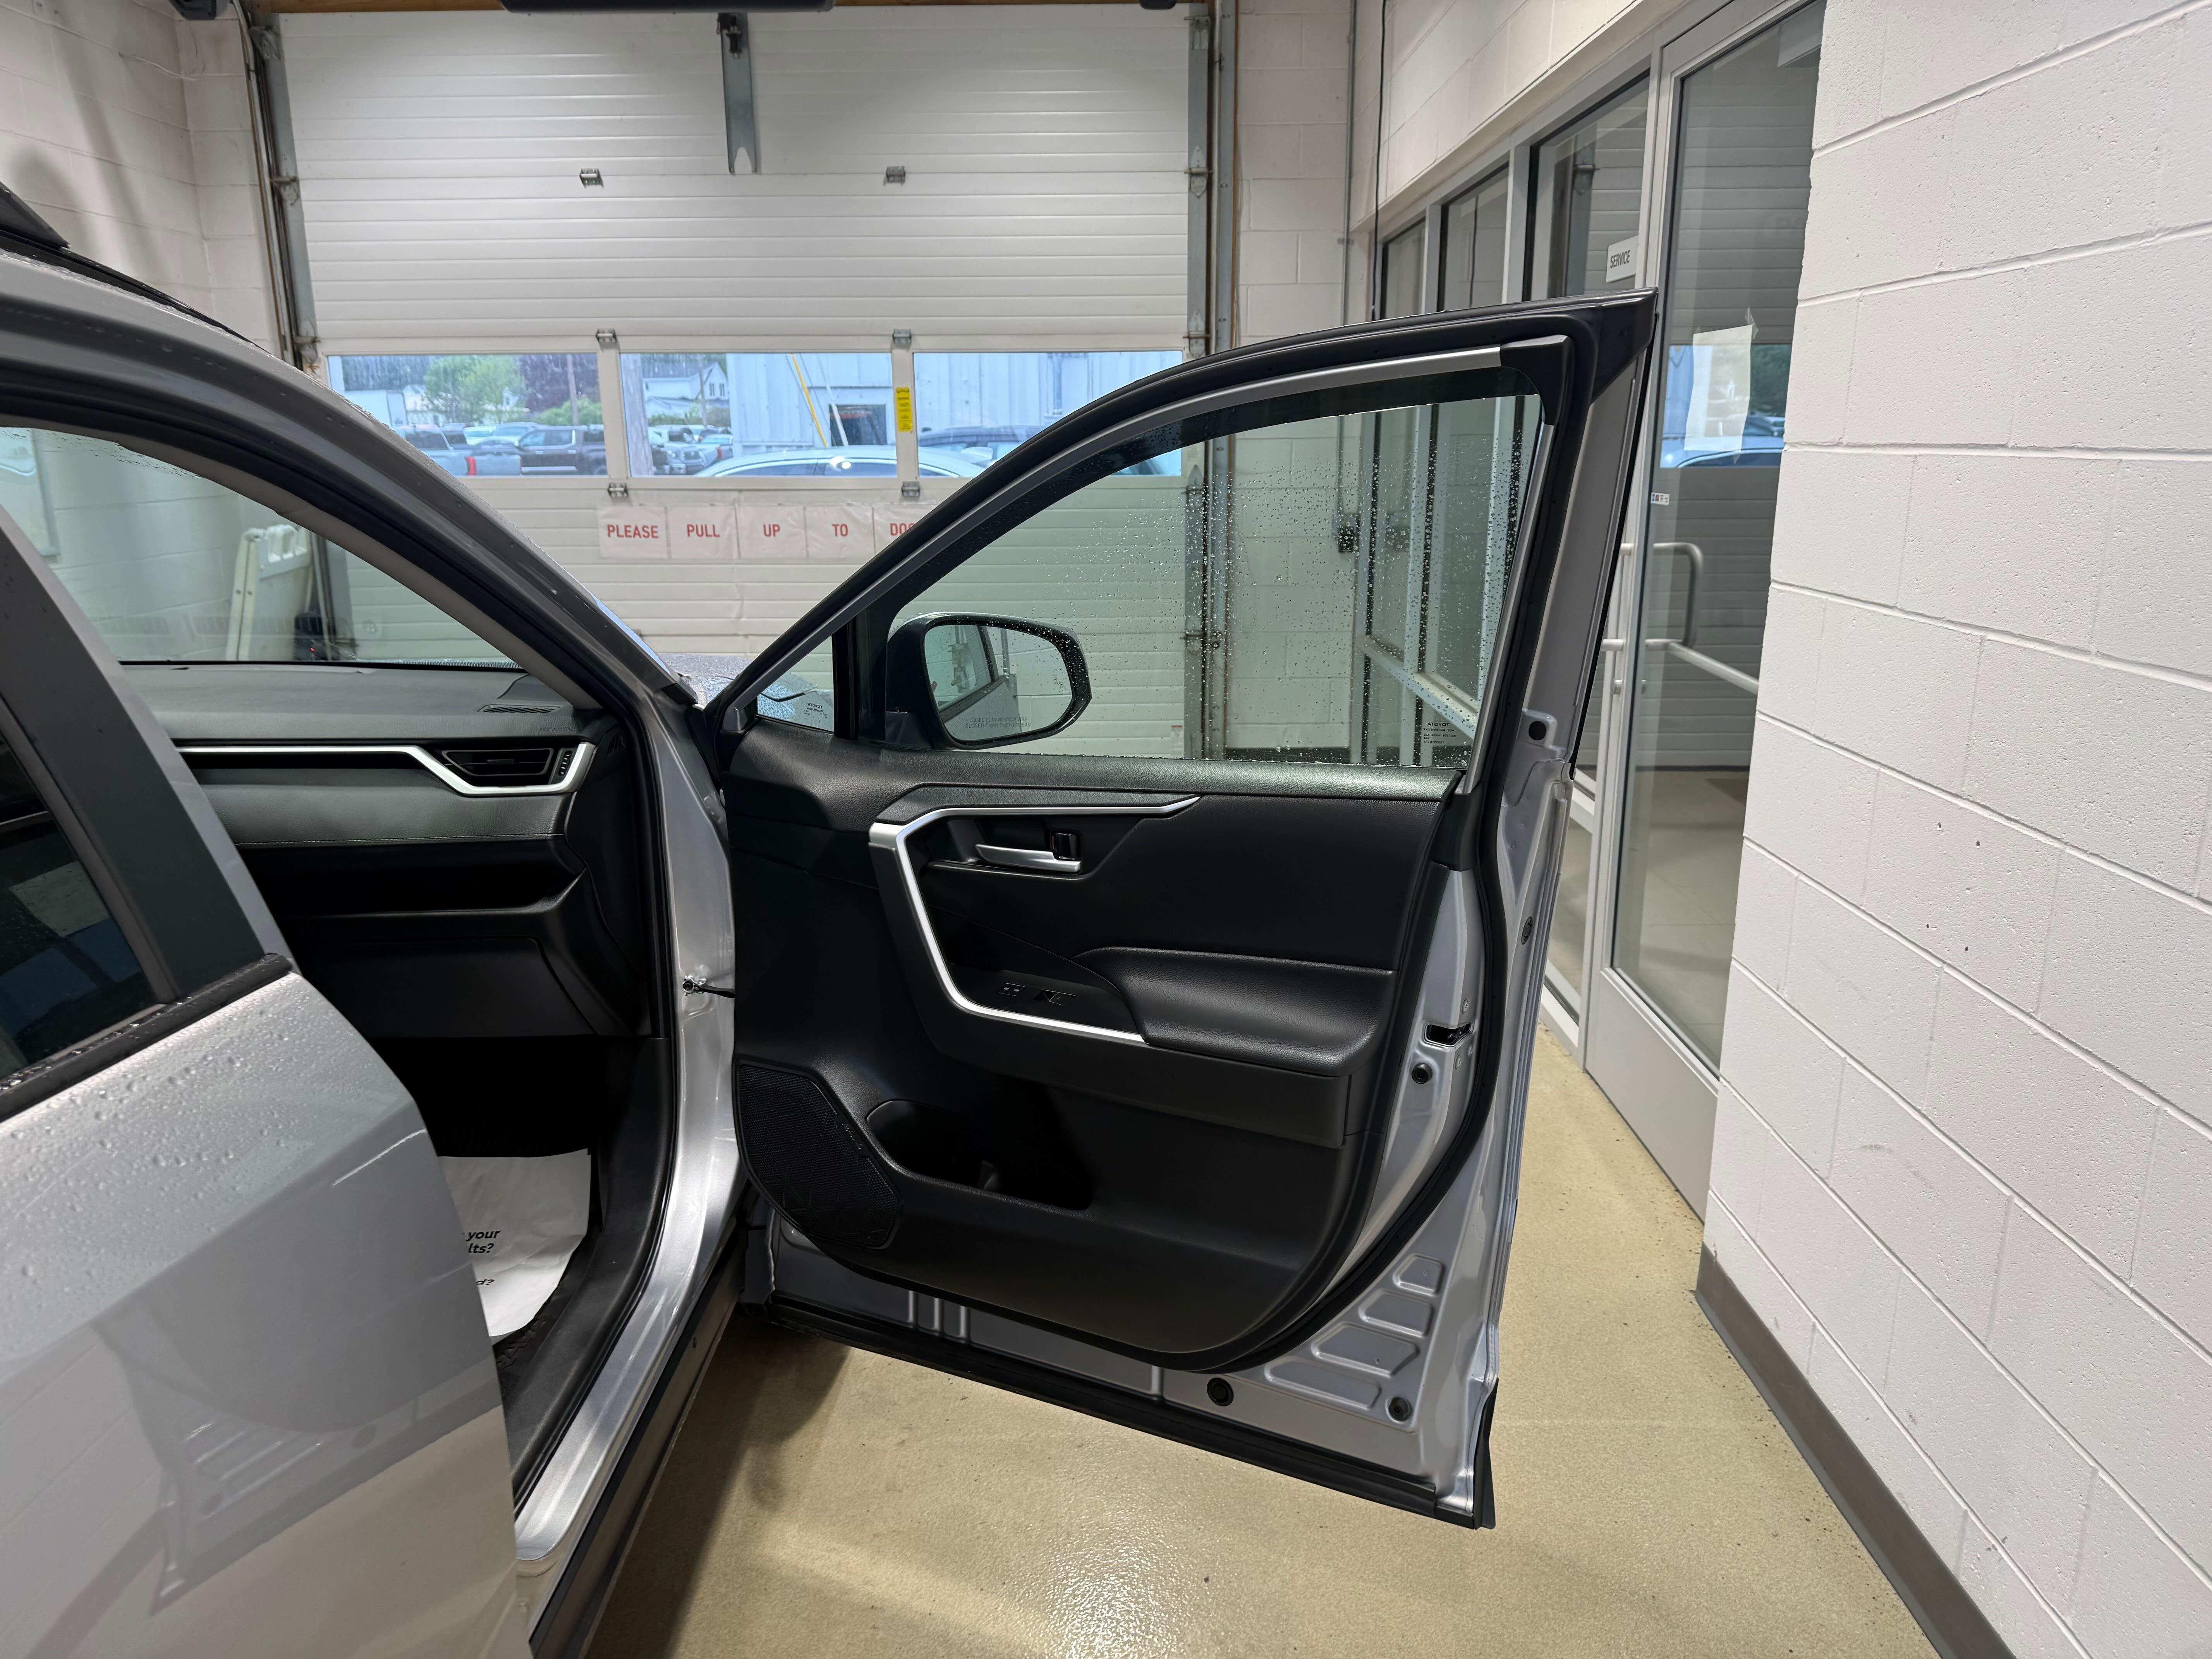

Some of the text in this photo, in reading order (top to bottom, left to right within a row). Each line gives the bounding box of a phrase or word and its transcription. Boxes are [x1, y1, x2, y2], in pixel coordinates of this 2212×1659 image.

[1611, 250, 1630, 268] SERVICE
[607, 523, 914, 538] PLEASE PULL UP TO DO
[466, 1230, 501, 1242] your
[468, 1243, 494, 1253] lts?
